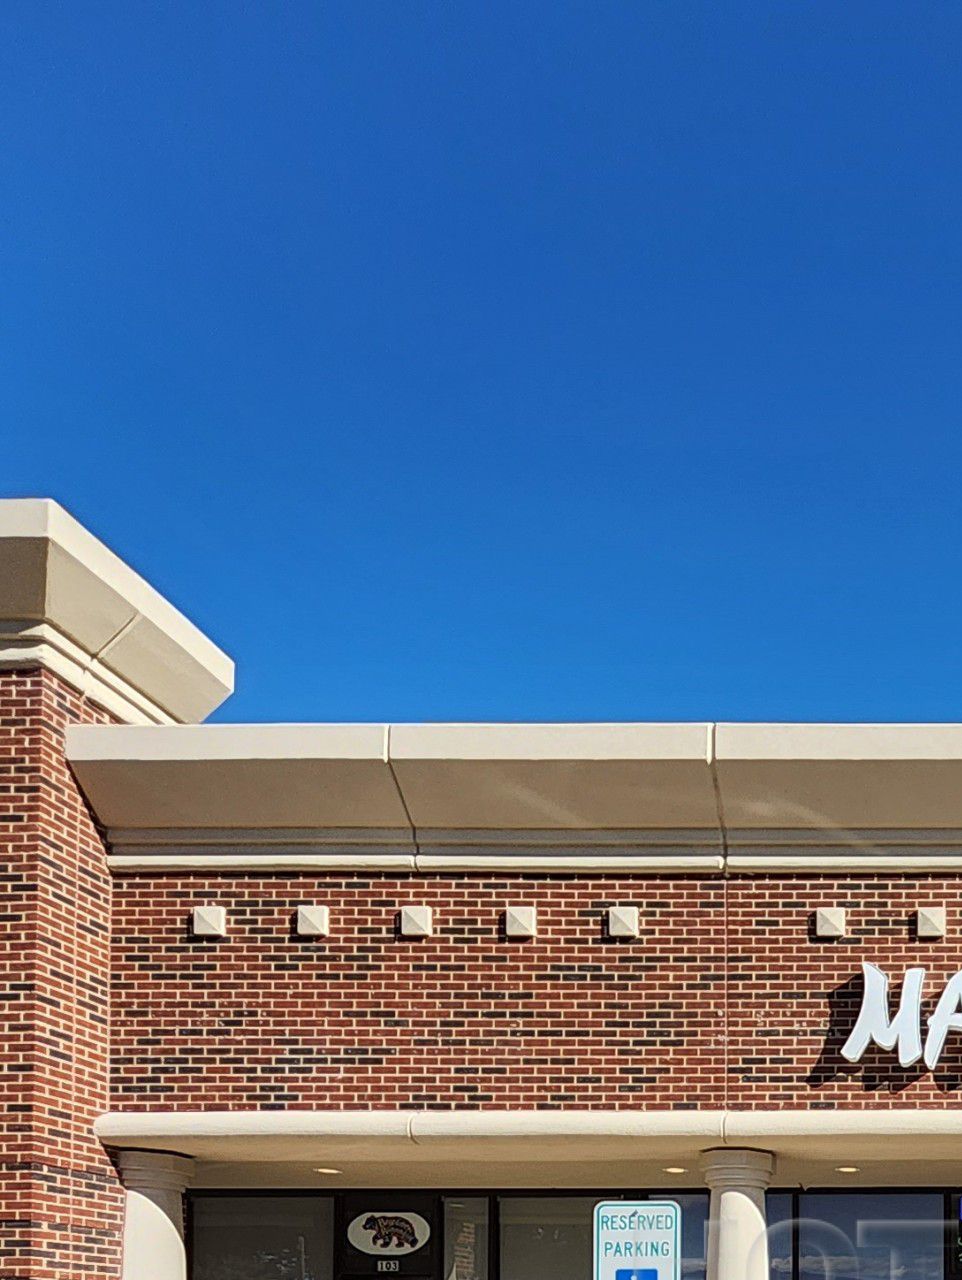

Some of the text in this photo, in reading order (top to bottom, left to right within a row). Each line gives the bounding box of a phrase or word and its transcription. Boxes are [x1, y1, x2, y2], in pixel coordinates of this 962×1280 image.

[600, 1214, 674, 1231] RESERVED
[604, 1241, 670, 1258] PARKING
[379, 1261, 398, 1271] 103
